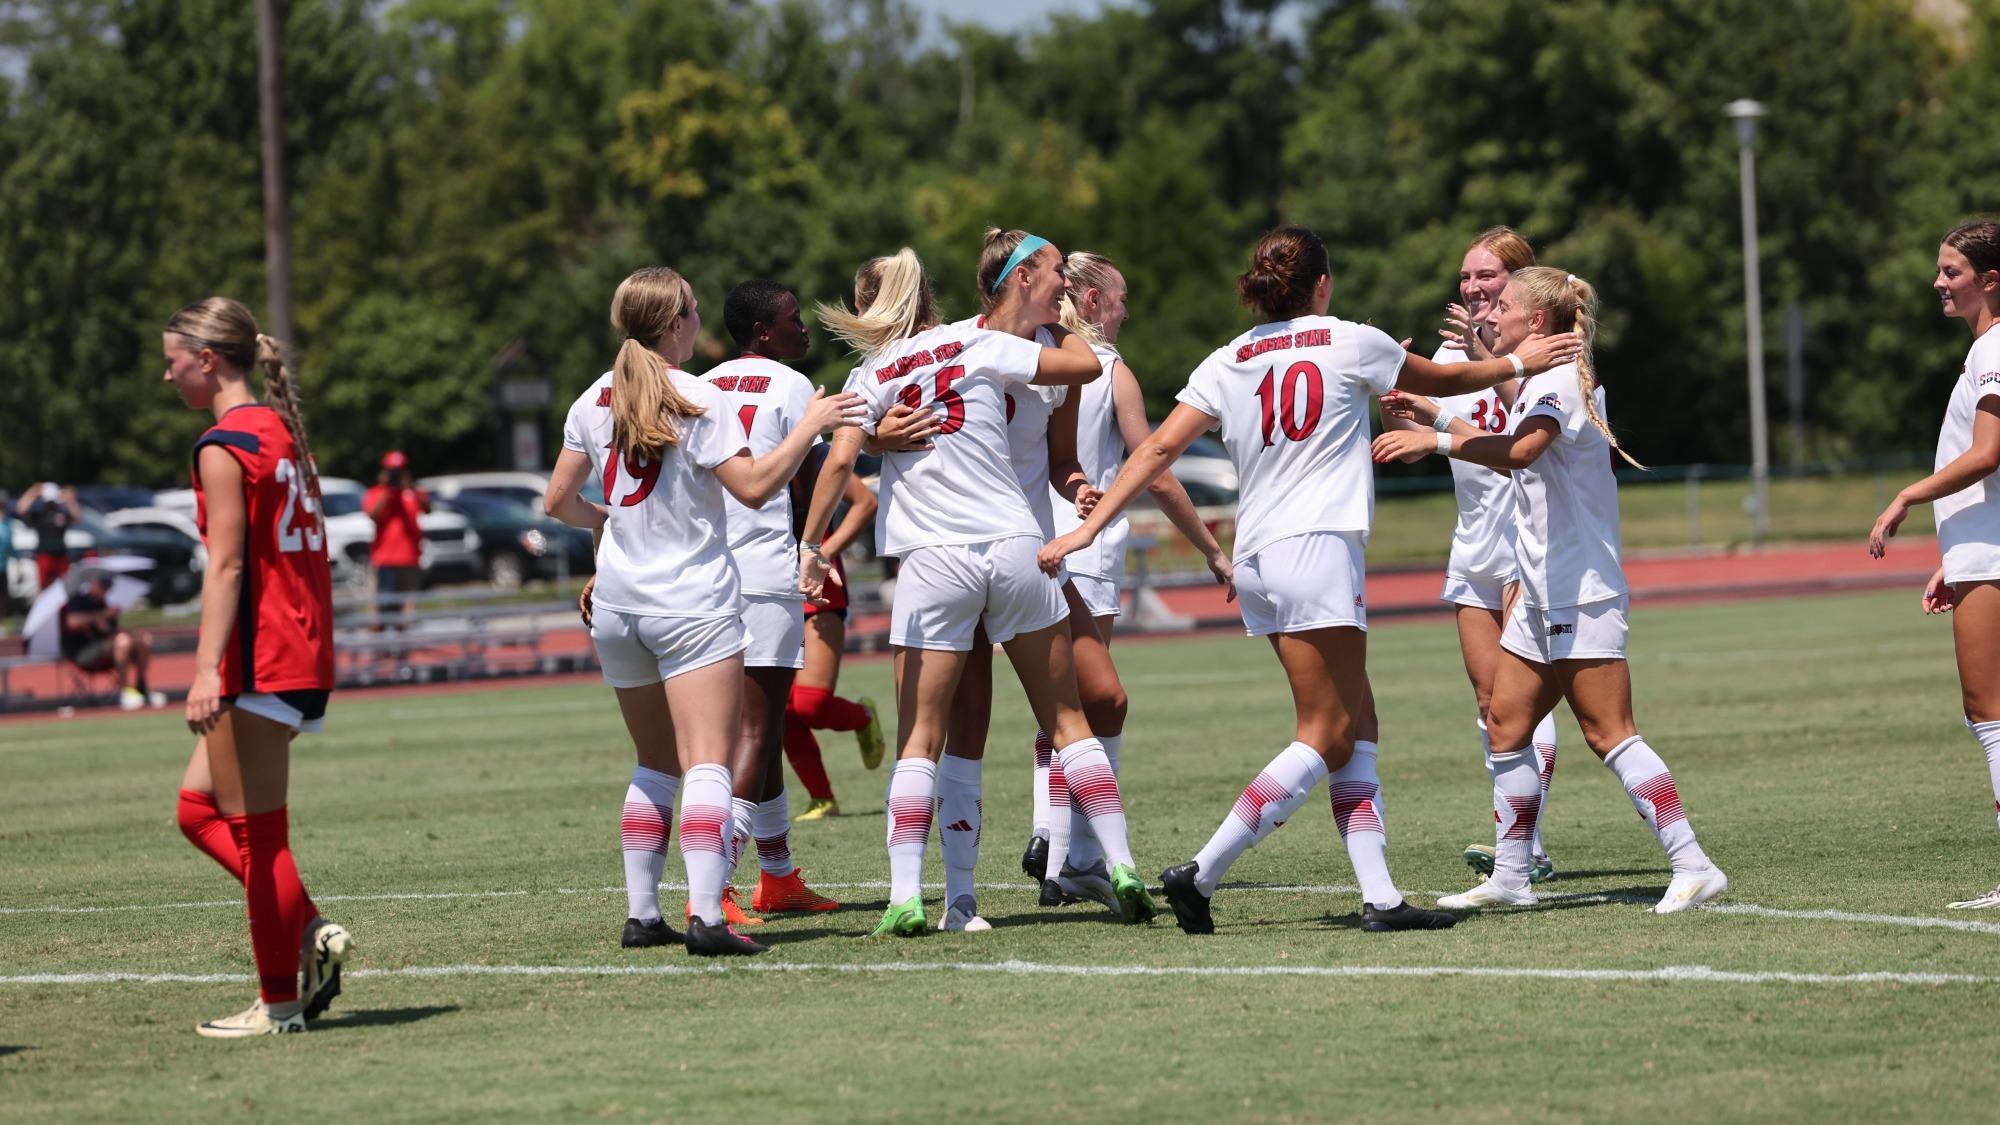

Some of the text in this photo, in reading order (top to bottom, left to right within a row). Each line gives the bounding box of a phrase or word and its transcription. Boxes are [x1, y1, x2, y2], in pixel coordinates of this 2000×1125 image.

[1236, 329, 1331, 363] ARKANSAS STATE
[737, 375, 772, 394] STATE
[875, 349, 935, 385] ARKANSAS
[1255, 360, 1324, 448] 10
[1471, 396, 1506, 433] 35
[603, 439, 663, 507] 19
